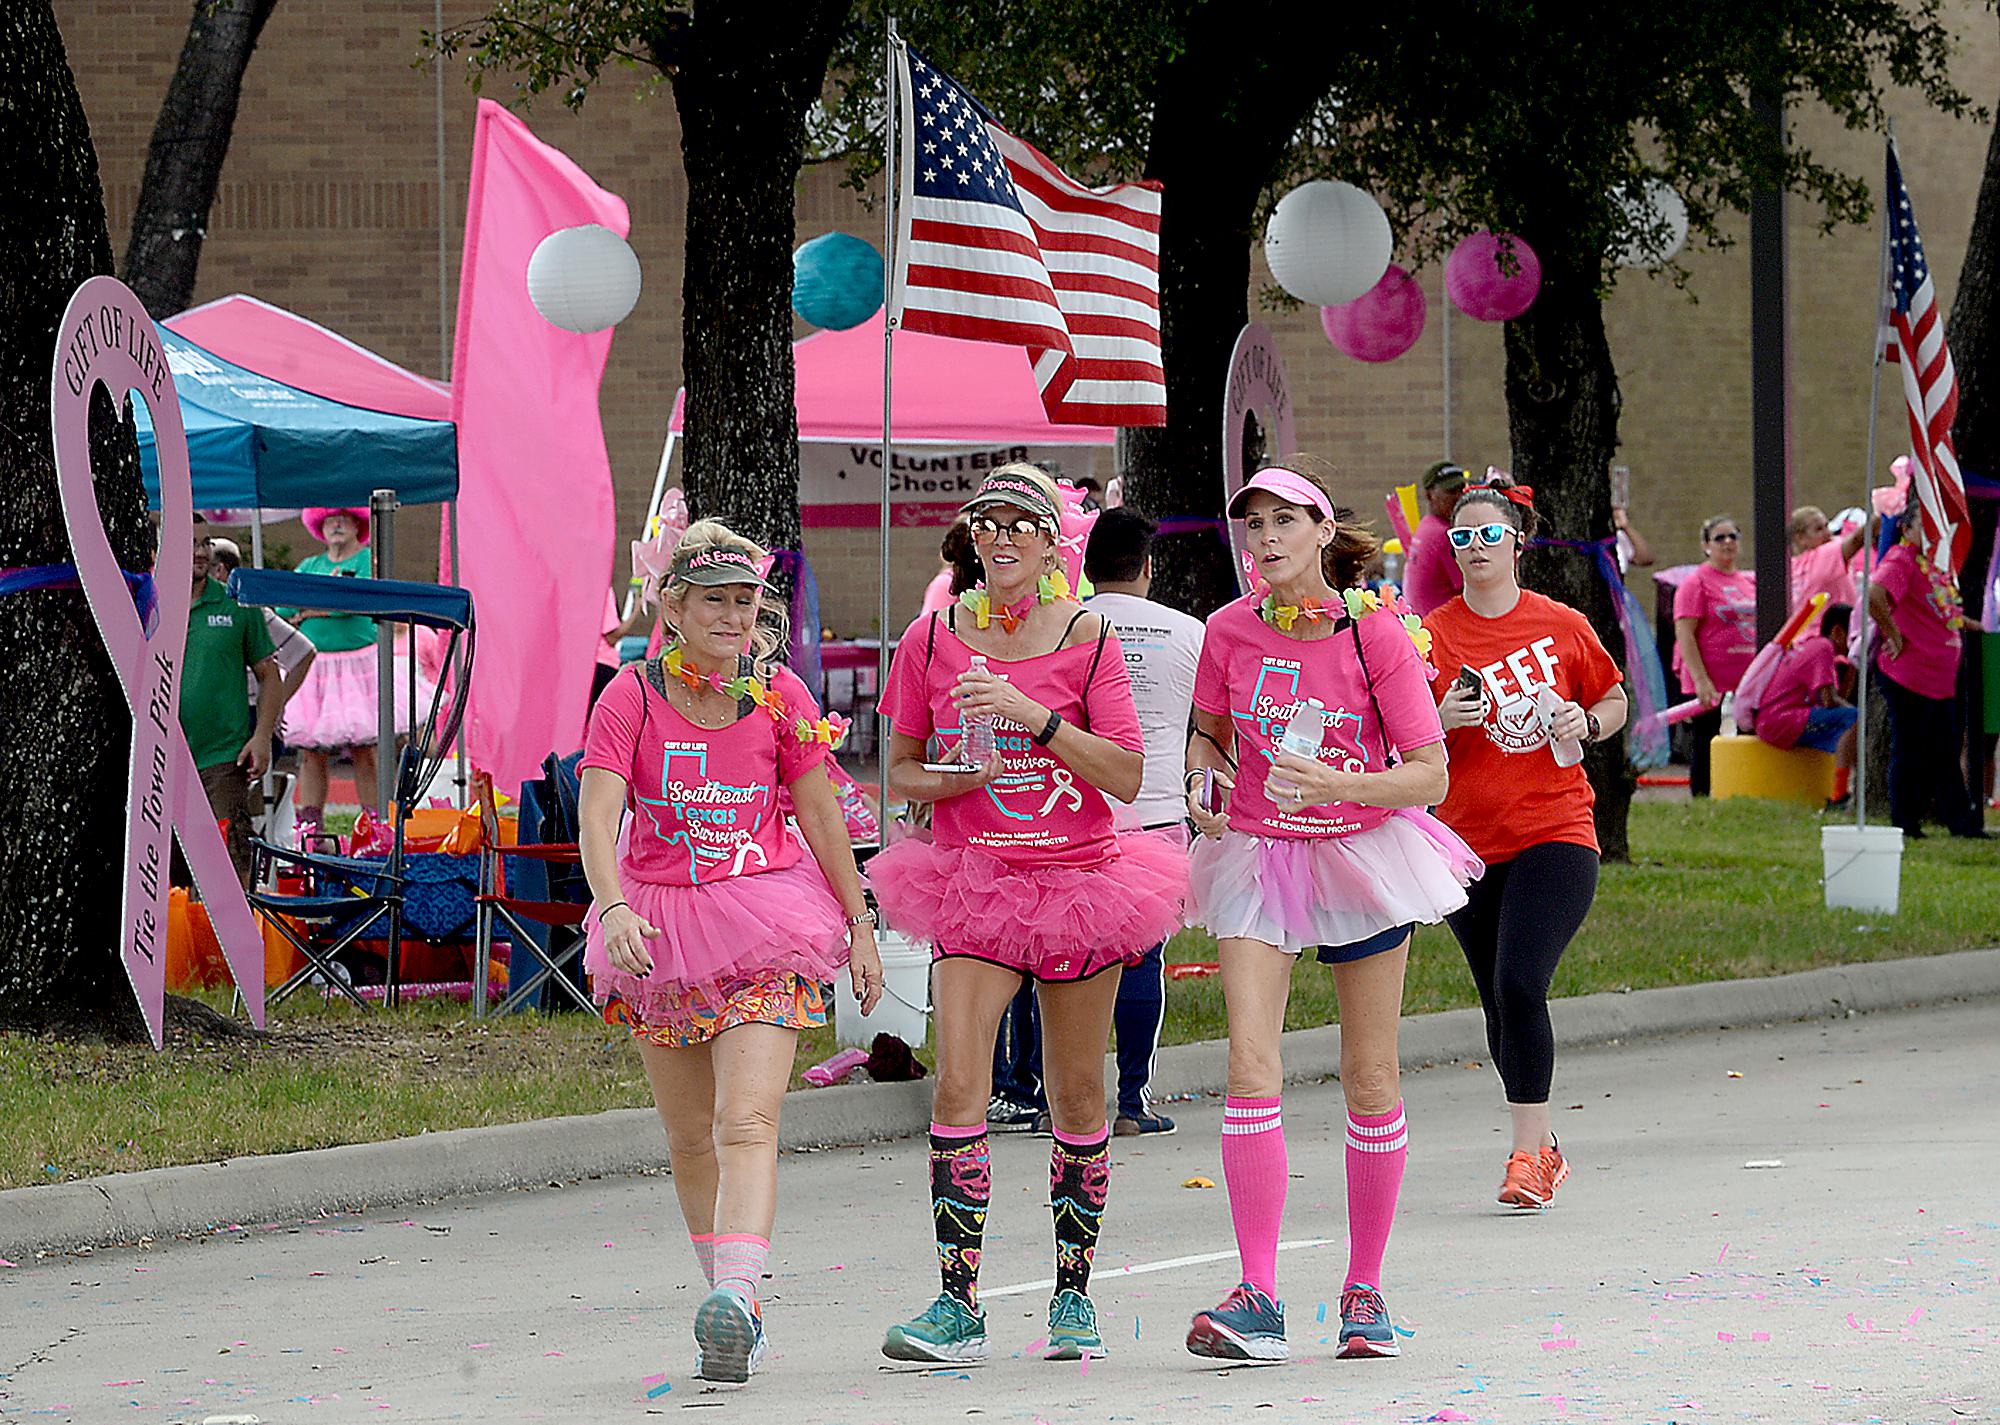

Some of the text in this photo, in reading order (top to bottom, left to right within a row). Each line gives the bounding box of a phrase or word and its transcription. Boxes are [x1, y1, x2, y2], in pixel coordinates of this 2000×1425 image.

[64, 305, 166, 403] GIFT OF LIFE
[1231, 345, 1287, 421] GIFT OF LIFE
[850, 446, 1028, 472] VOLUNTEER
[996, 736, 1032, 751] xas
[1002, 753, 1058, 770] rvivor
[668, 779, 758, 804] Southeast
[133, 649, 175, 966] Tie the Town Pink
[671, 802, 737, 824] Texas
[1280, 821, 1326, 834] RICHARDSON
[1326, 822, 1362, 834] PROCTER
[1034, 835, 1070, 847] PROCTER
